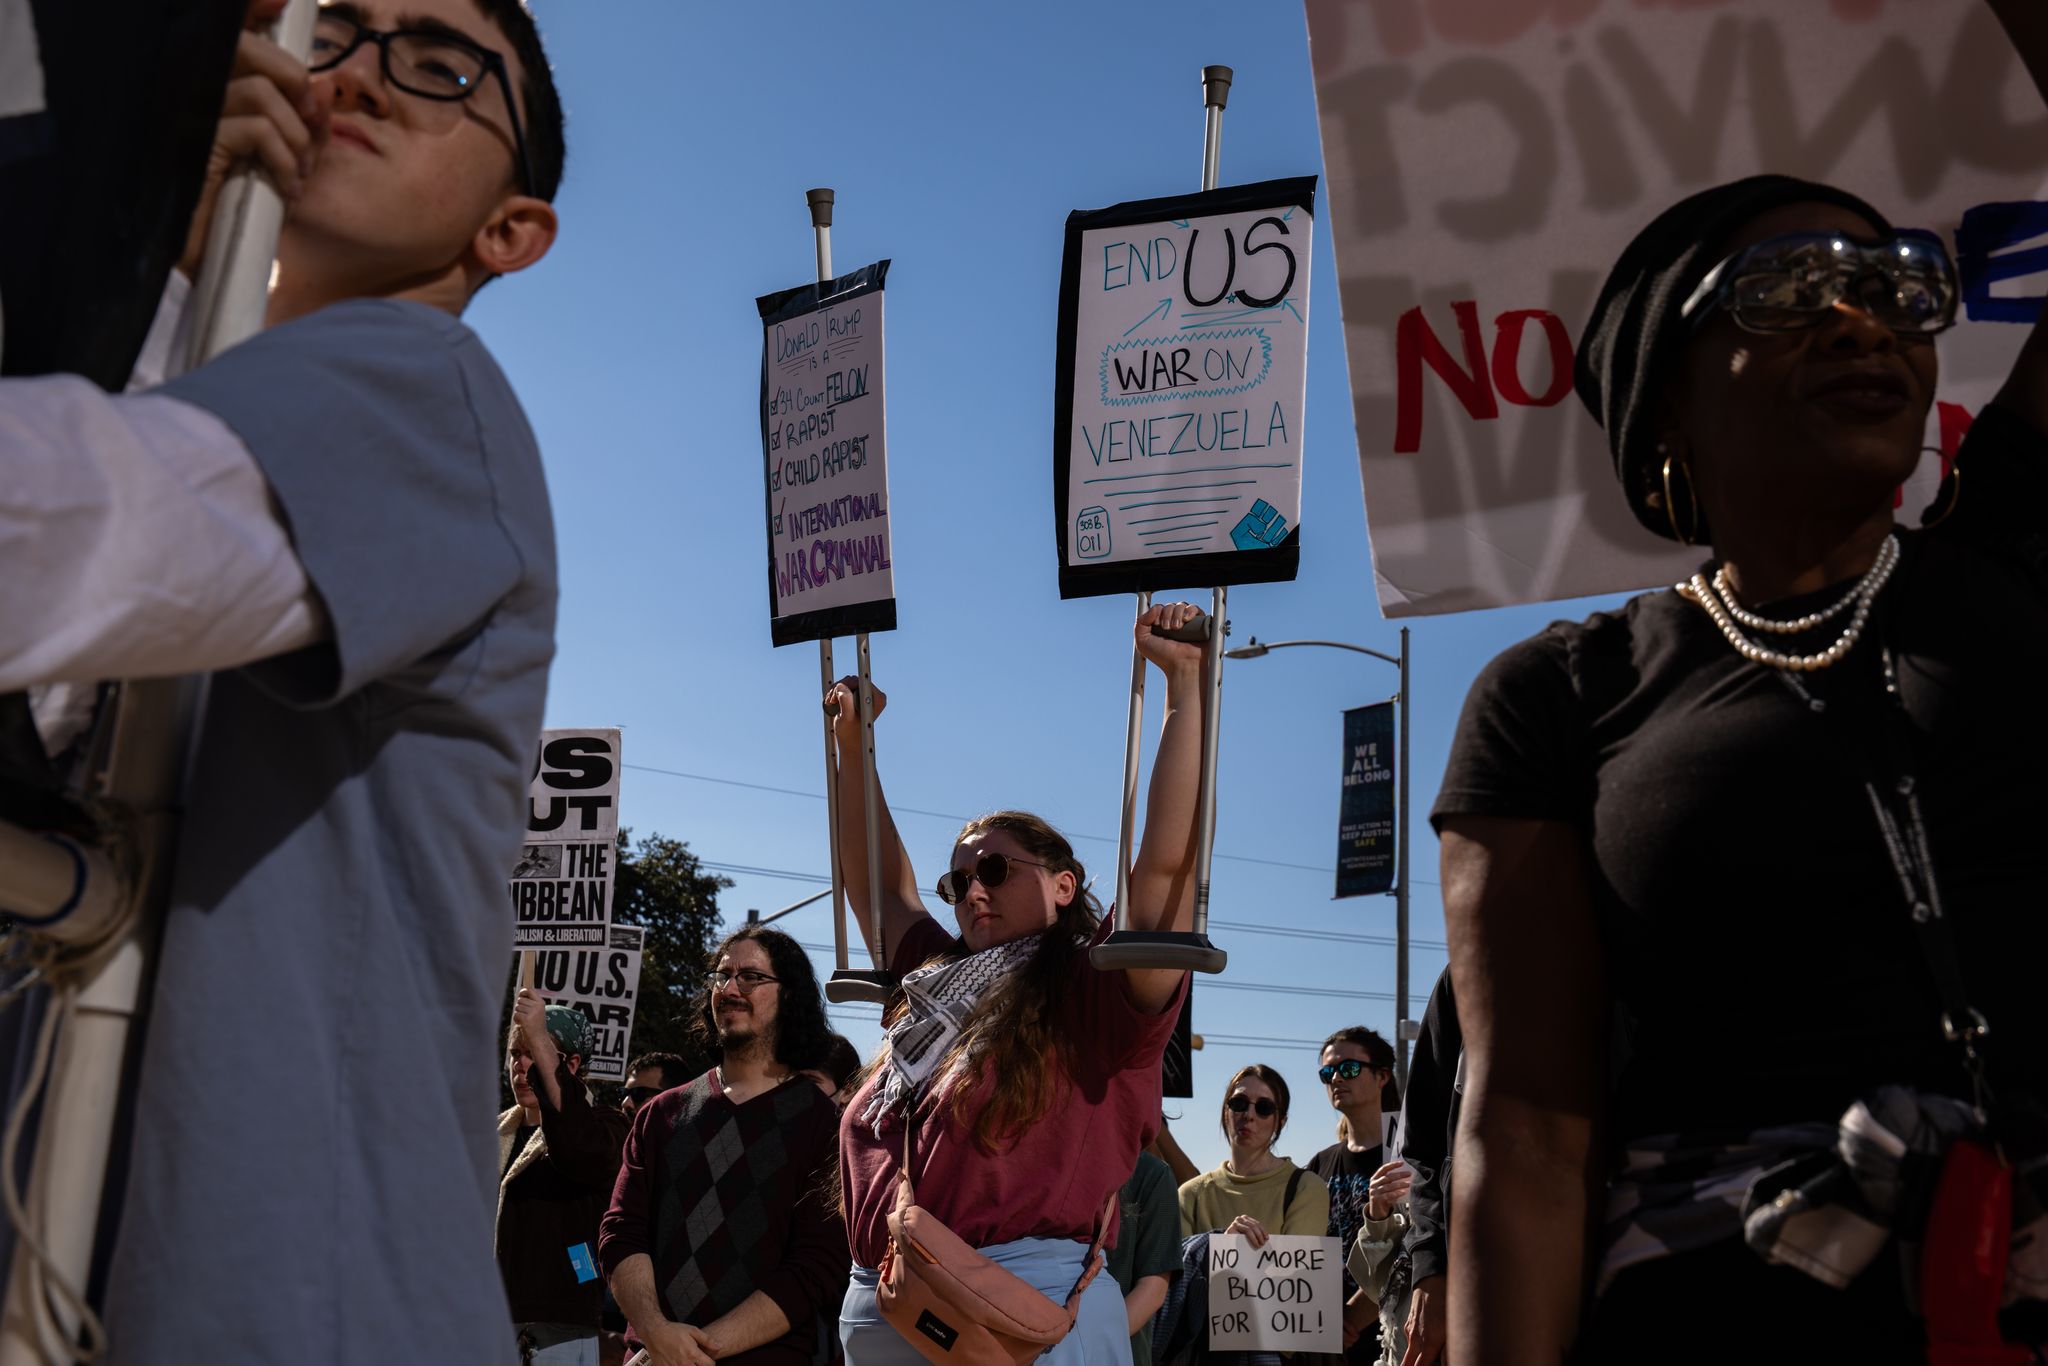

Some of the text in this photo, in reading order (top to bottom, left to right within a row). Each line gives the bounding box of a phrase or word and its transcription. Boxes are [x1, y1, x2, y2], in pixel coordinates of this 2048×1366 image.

[1104, 216, 1297, 308] END US
[776, 307, 861, 363] DONALD TRUMP
[809, 350, 830, 371] IS A
[1114, 347, 1252, 391] WAR ON
[780, 388, 793, 415] 34
[826, 363, 869, 404] FELON
[786, 409, 836, 450] RAPIST
[1082, 401, 1288, 466] VENEZUELA
[785, 434, 870, 487] CHILD RAPIST
[789, 493, 887, 542] INTERNATIONAL
[1352, 757, 1381, 772] ALL
[1355, 743, 1377, 757] WE
[1343, 769, 1391, 786] BELONG
[528, 795, 612, 832] UT
[1354, 838, 1376, 847] SAFE
[1361, 828, 1391, 838] AUSTIN
[566, 844, 608, 878] THE
[508, 880, 606, 922] IBBEAN
[513, 928, 603, 942] CIALISM & LIBERATION
[574, 951, 633, 999] U.S.
[1212, 1249, 1325, 1271] NO MORE
[1227, 1276, 1313, 1304] BLOOD
[1211, 1310, 1324, 1336] FOR OIL!
